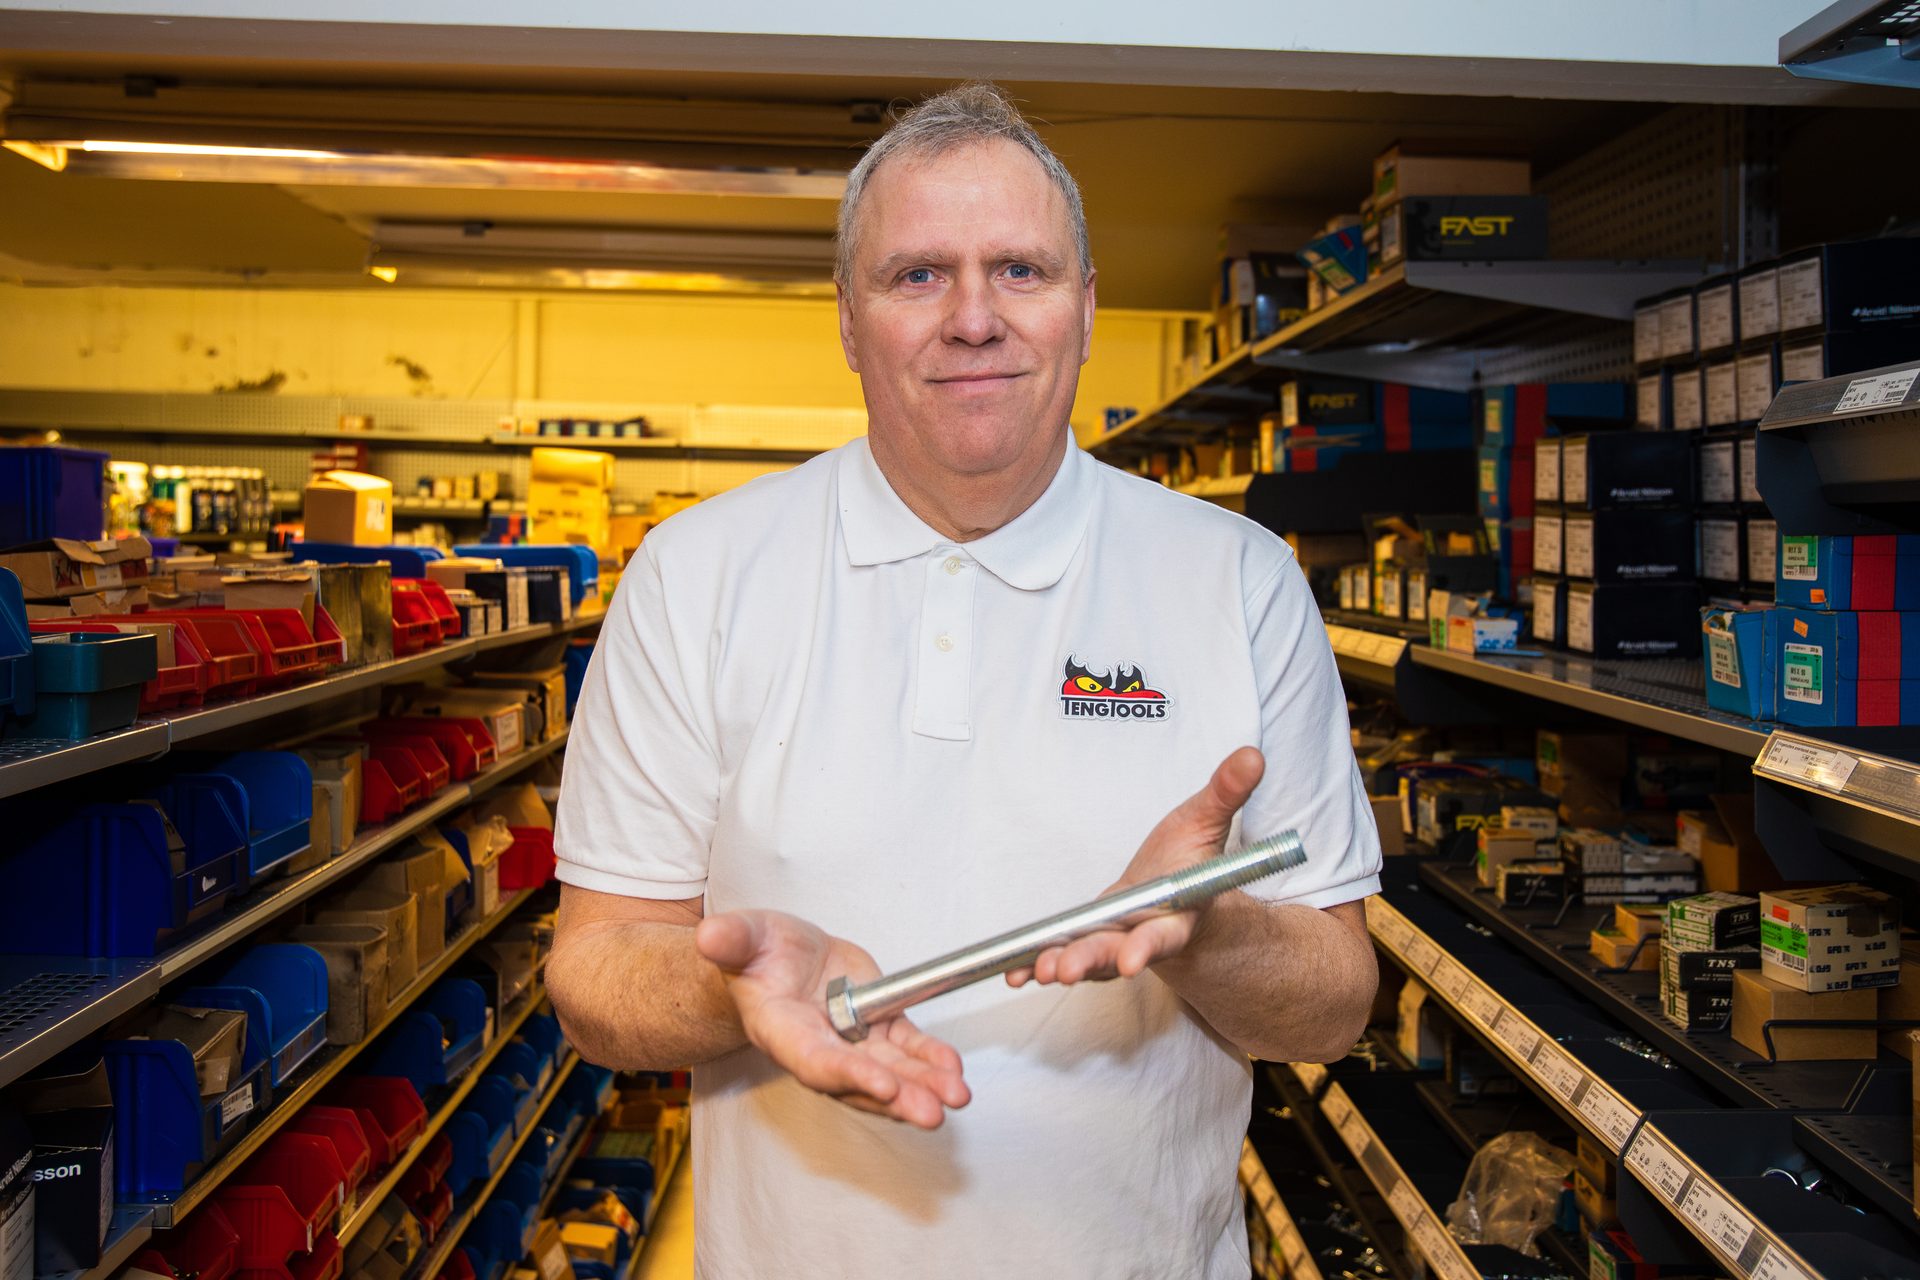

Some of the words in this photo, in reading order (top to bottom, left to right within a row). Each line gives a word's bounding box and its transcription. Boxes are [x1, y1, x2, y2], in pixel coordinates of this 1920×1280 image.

[1439, 215, 1515, 237] FAST
[1308, 392, 1359, 409] FAST
[1060, 696, 1166, 718] TENGTOOLS
[1455, 813, 1503, 832] FAS
[1732, 911, 1750, 923] TNS
[1707, 959, 1737, 969] TNS
[33, 1163, 82, 1182] sson
